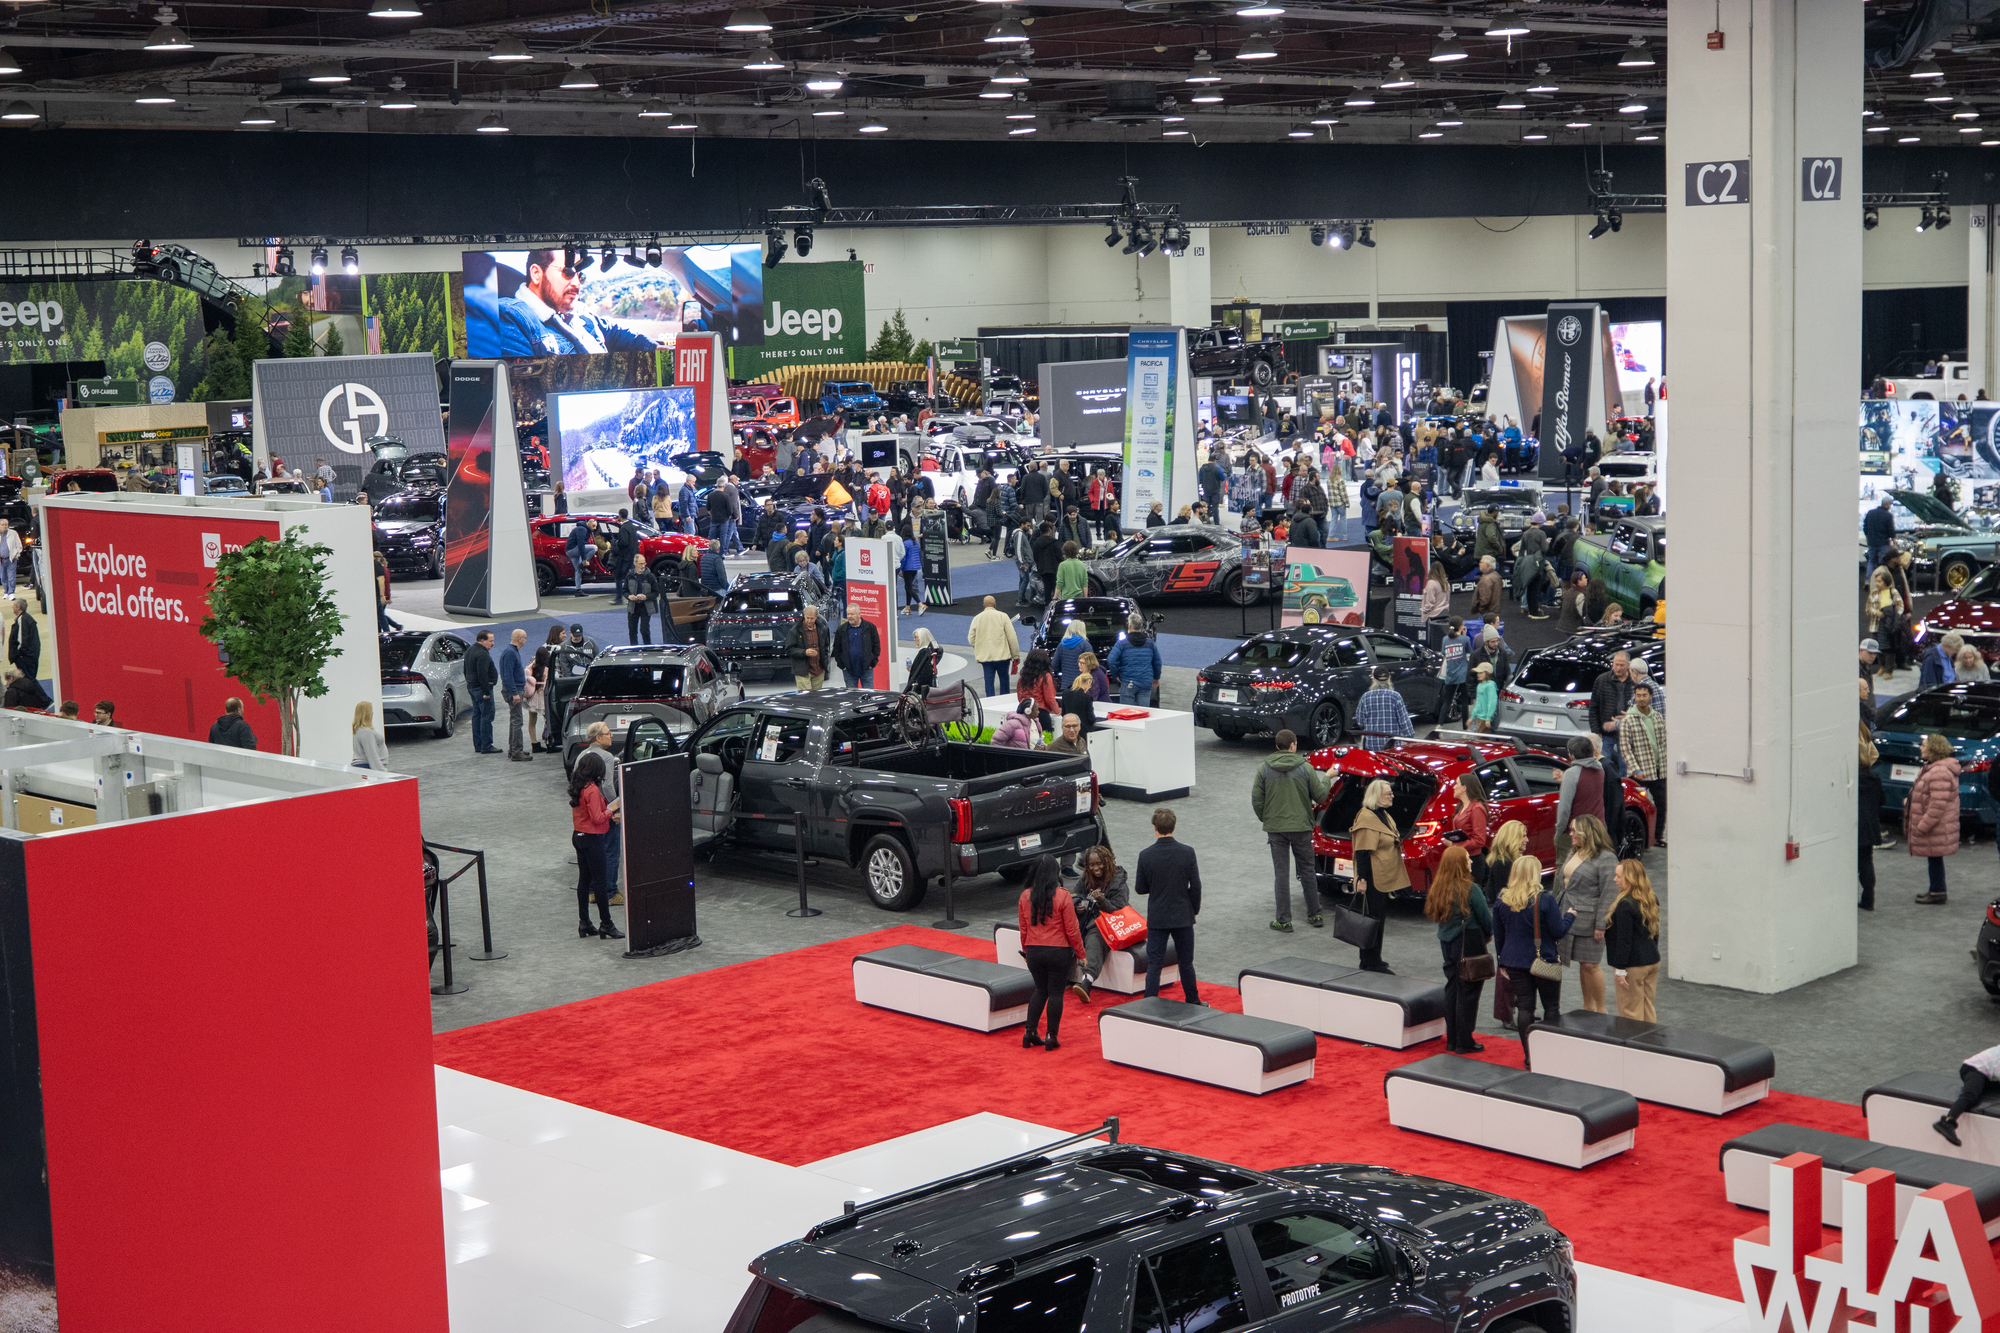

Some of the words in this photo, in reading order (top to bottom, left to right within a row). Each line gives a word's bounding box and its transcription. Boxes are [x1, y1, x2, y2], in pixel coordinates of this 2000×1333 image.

[1697, 162, 1738, 203] C2
[1810, 159, 1836, 198] C2
[1247, 225, 1289, 236] ESCALATOR
[1972, 217, 1985, 227] D3
[1195, 247, 1204, 256] D4
[863, 263, 874, 273] XIT
[0, 300, 64, 332] eep
[763, 301, 842, 341] Jeep
[17, 339, 43, 347] ONLY
[47, 338, 68, 346] ONE
[760, 350, 797, 359] THERE'S
[800, 348, 823, 358] ONLY
[827, 347, 844, 356] ONE
[679, 348, 708, 382] FIAT
[91, 388, 119, 396] OFF-CAMBER
[1075, 387, 1127, 396] CHRYSLER
[1556, 351, 1572, 415] Romeo
[1555, 417, 1572, 453] Alfa
[75, 542, 147, 583] Explore
[78, 580, 124, 616] local
[127, 586, 190, 623] offers.
[863, 596, 879, 604] Toyota.
[1001, 795, 1070, 818] TUNDRA
[1111, 920, 1125, 931] Go
[1116, 921, 1142, 938] Places
[1281, 1283, 1322, 1307] PROTOTYPE
